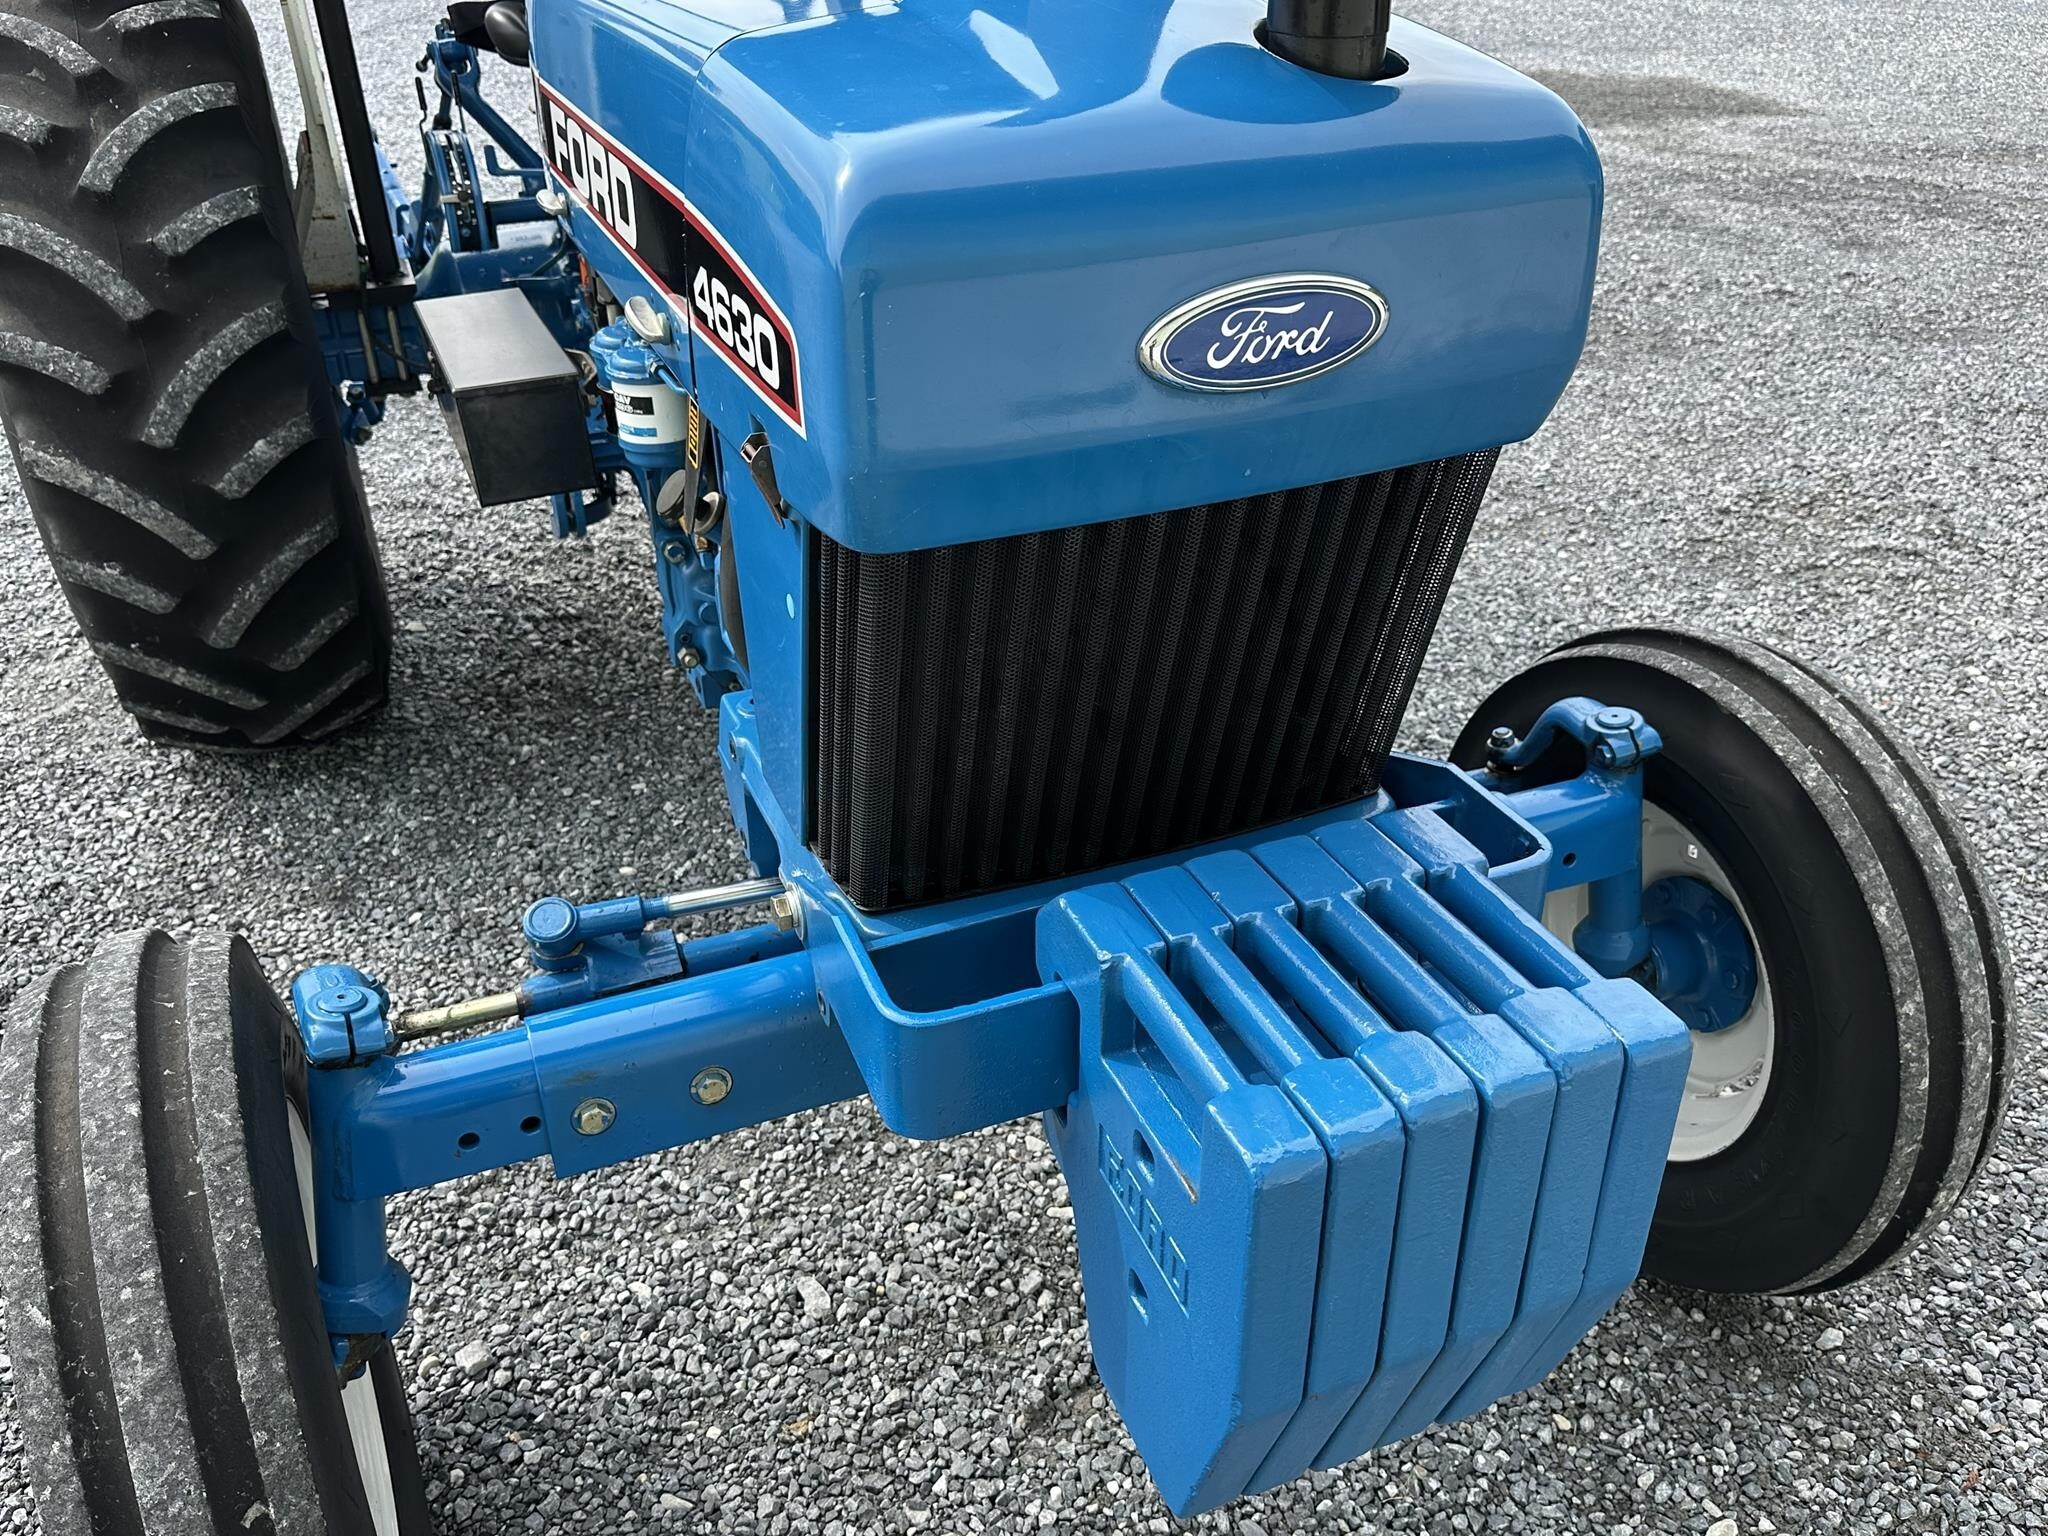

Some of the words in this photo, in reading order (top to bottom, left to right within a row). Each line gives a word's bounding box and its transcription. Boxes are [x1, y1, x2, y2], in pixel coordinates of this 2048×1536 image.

[549, 100, 638, 250] FORD
[692, 266, 780, 391] 4630
[1206, 301, 1335, 370] Ford
